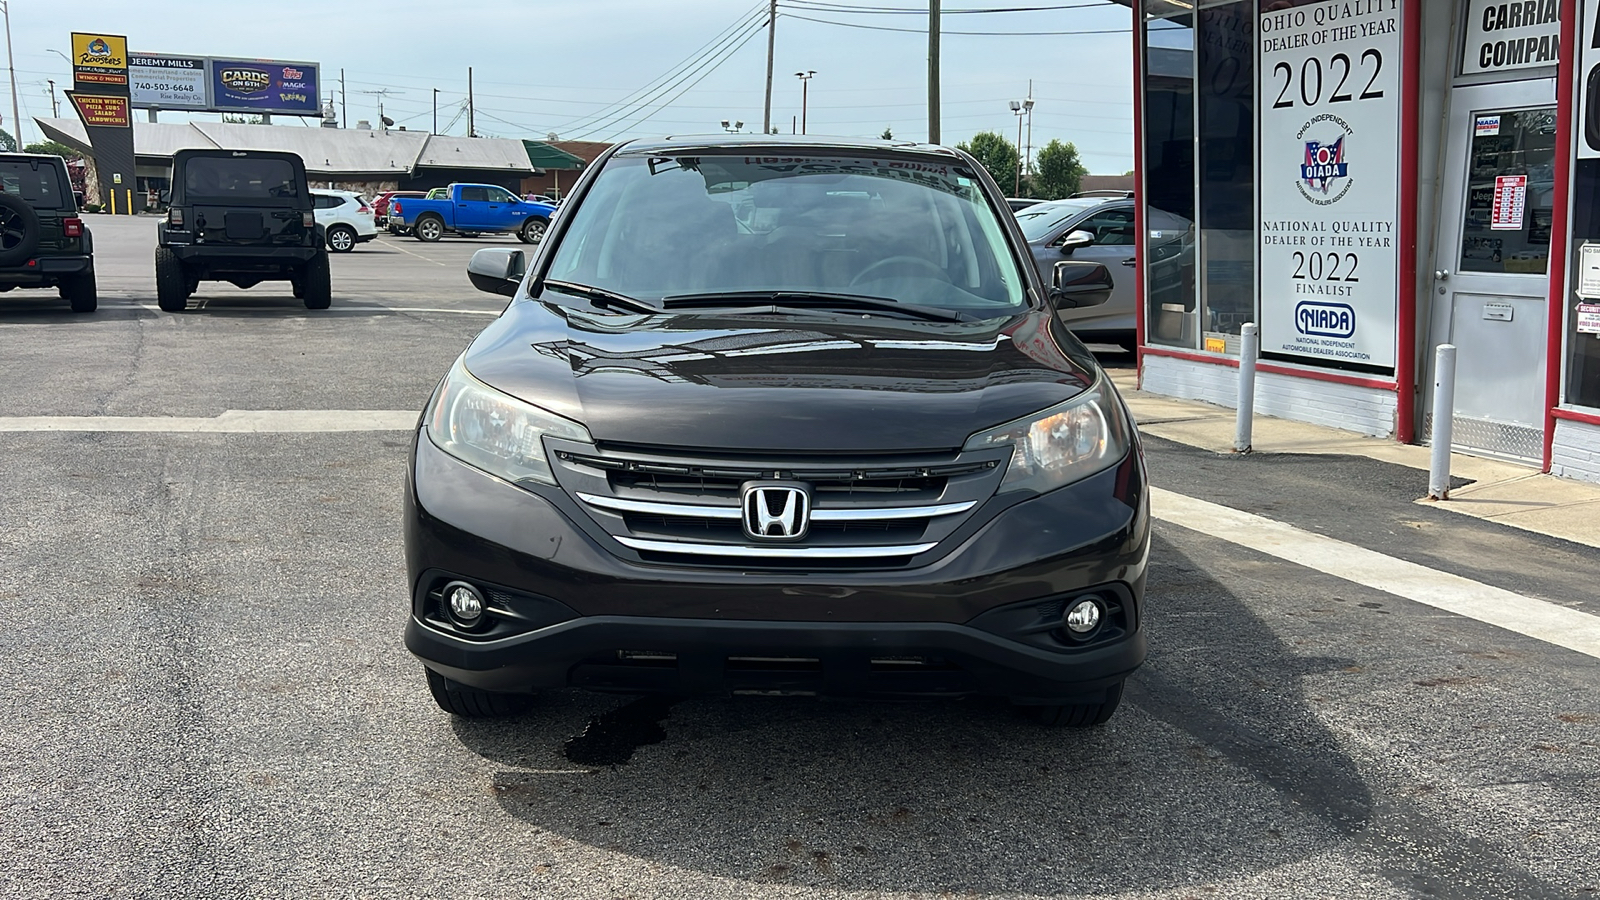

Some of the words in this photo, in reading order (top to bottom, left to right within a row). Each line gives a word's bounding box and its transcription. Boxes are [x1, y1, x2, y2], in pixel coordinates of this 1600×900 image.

[1262, 11, 1305, 33] OHIO
[1314, 0, 1396, 26] QUALITY
[1482, 0, 1561, 32] CARRIA
[1264, 33, 1309, 53] DEALER
[1312, 29, 1328, 45] OF
[1331, 25, 1357, 42] THE
[1361, 18, 1396, 37] YEAR
[1479, 34, 1560, 69] COMPAN
[79, 53, 122, 66] Roosters
[132, 58, 166, 67] JEREMY
[168, 60, 194, 68] MILLS
[167, 75, 196, 83] Properties
[222, 71, 270, 84] CARDS
[1272, 48, 1384, 109] 2022
[135, 83, 194, 93] 740-503-6648
[173, 94, 191, 102] Realty
[88, 116, 126, 124] SANDWICHES
[1296, 121, 1310, 140] OHIO
[1310, 113, 1353, 136] INDEPENDENT
[1306, 164, 1339, 178] OIADA
[1296, 180, 1315, 204] AUTOMOBILE
[1315, 198, 1332, 206] DEALERS
[1332, 178, 1353, 203] ASSOCIATION
[1473, 191, 1493, 202] Jeep
[1263, 221, 1327, 231] NATIONAL
[1332, 221, 1393, 234] QUALITY
[1264, 235, 1306, 246] DEALER
[1311, 236, 1325, 246] OF
[1330, 236, 1353, 247] THE
[1358, 237, 1391, 248] YEAR
[1292, 251, 1359, 282] 2022
[1296, 283, 1353, 297] FINALIST
[1300, 308, 1350, 333] NIADA
[1295, 336, 1320, 346] NATIONAL
[1320, 338, 1356, 349] INDEPENDENT
[1282, 344, 1313, 354] AUTOMOBILE
[1313, 347, 1335, 356] DEALERS
[1334, 350, 1371, 360] ASSOCIATION
